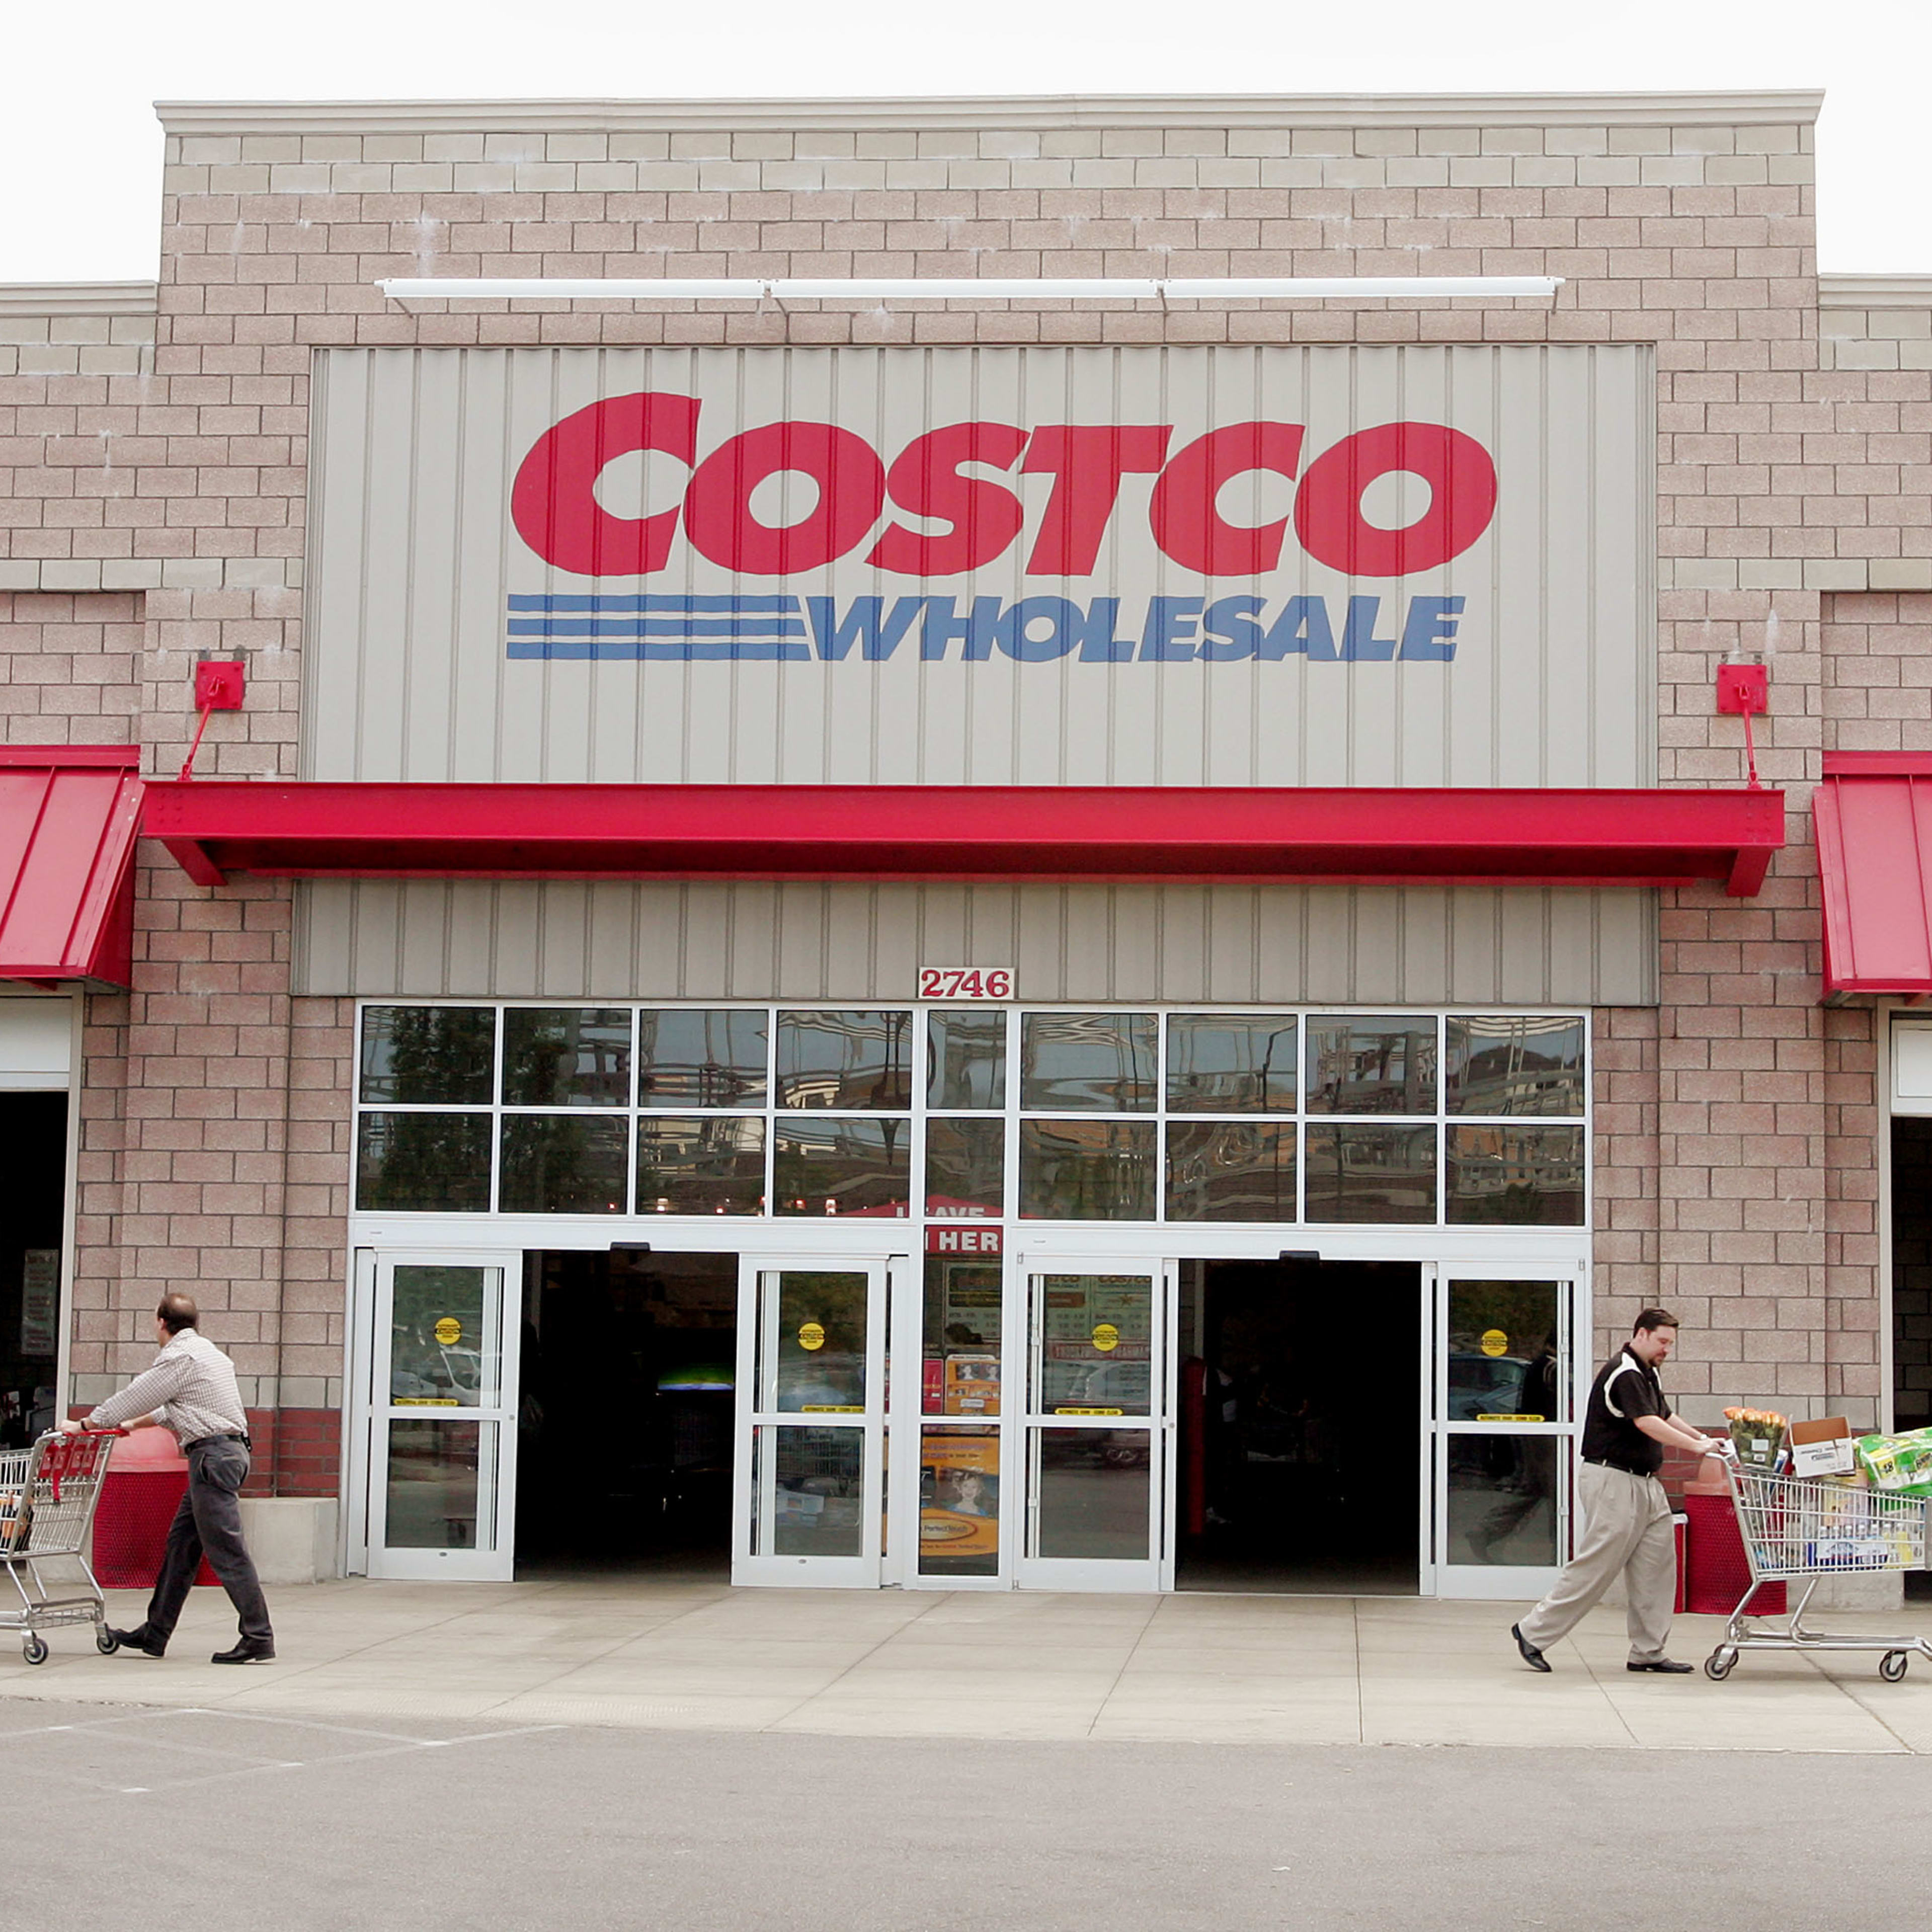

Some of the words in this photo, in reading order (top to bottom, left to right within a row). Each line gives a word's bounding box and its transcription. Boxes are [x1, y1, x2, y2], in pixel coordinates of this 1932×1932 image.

[512, 393, 1496, 577] COSTCO
[806, 596, 1464, 662] WHOLESALE
[922, 970, 1008, 997] 2746
